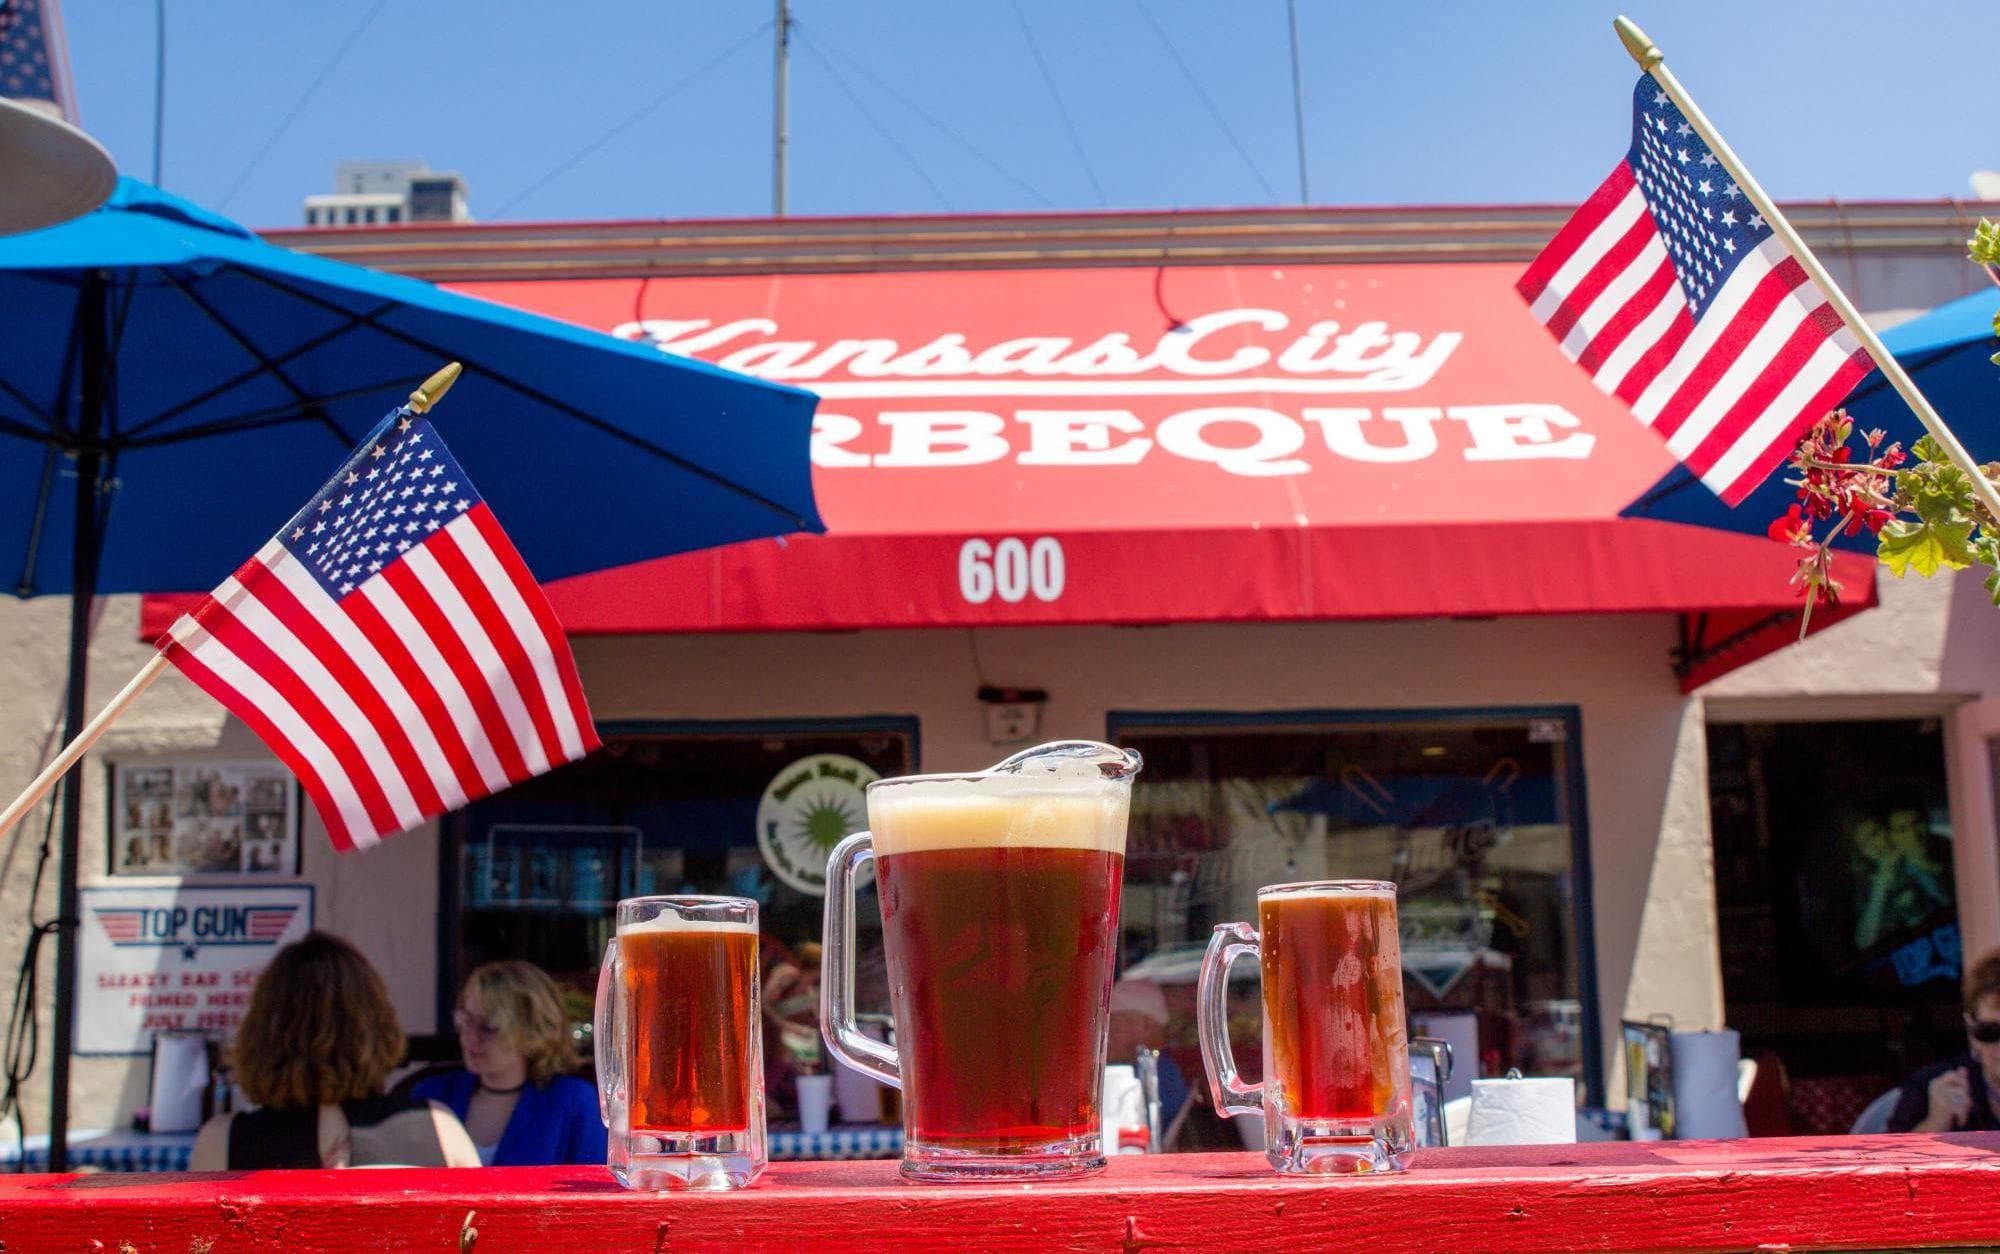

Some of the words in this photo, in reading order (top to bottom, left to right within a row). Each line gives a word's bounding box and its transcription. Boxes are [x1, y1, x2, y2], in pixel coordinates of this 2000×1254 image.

[1153, 308, 1463, 393] City
[810, 403, 1597, 477] RBEQUE
[958, 536, 1066, 604] 600
[139, 907, 187, 937] TOP
[193, 906, 247, 937] GUN
[181, 971, 220, 987] BAR
[207, 991, 250, 1007] HER
